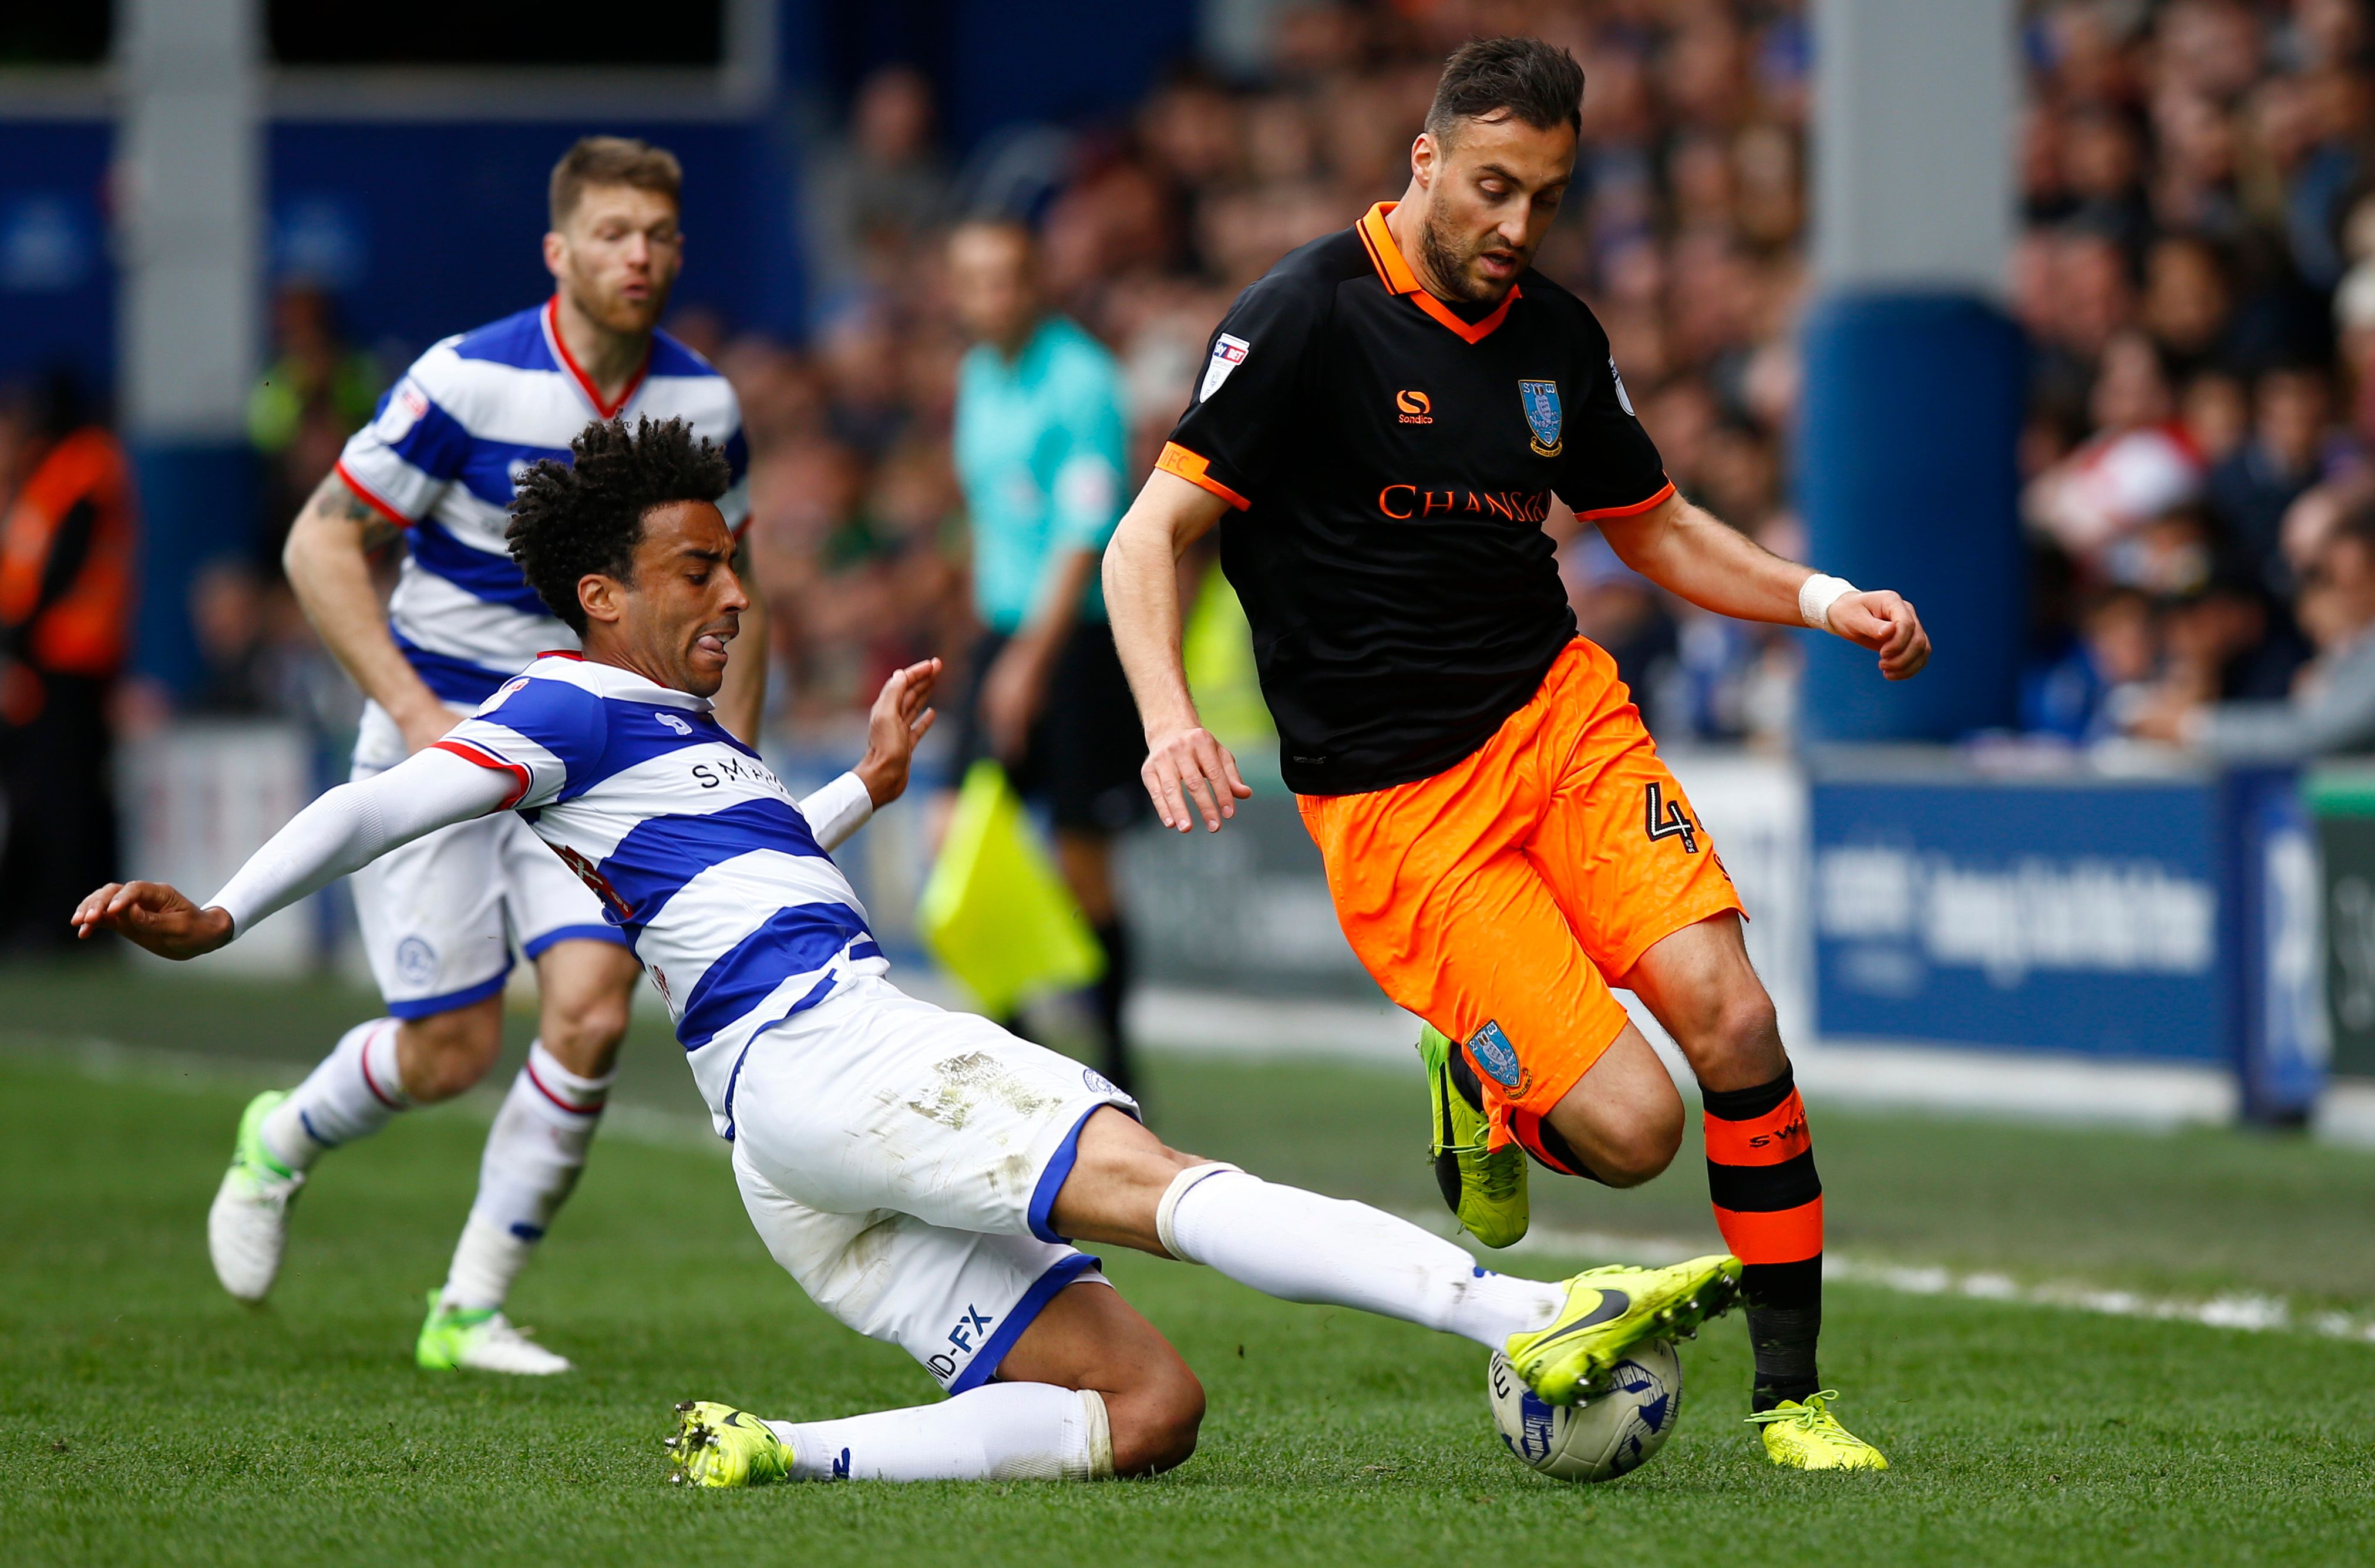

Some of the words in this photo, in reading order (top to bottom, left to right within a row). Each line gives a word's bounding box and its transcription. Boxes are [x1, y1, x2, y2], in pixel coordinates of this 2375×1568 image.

[1227, 348, 1244, 361] BET
[1398, 414, 1433, 424] Sondico
[1645, 782, 1705, 854] 4
